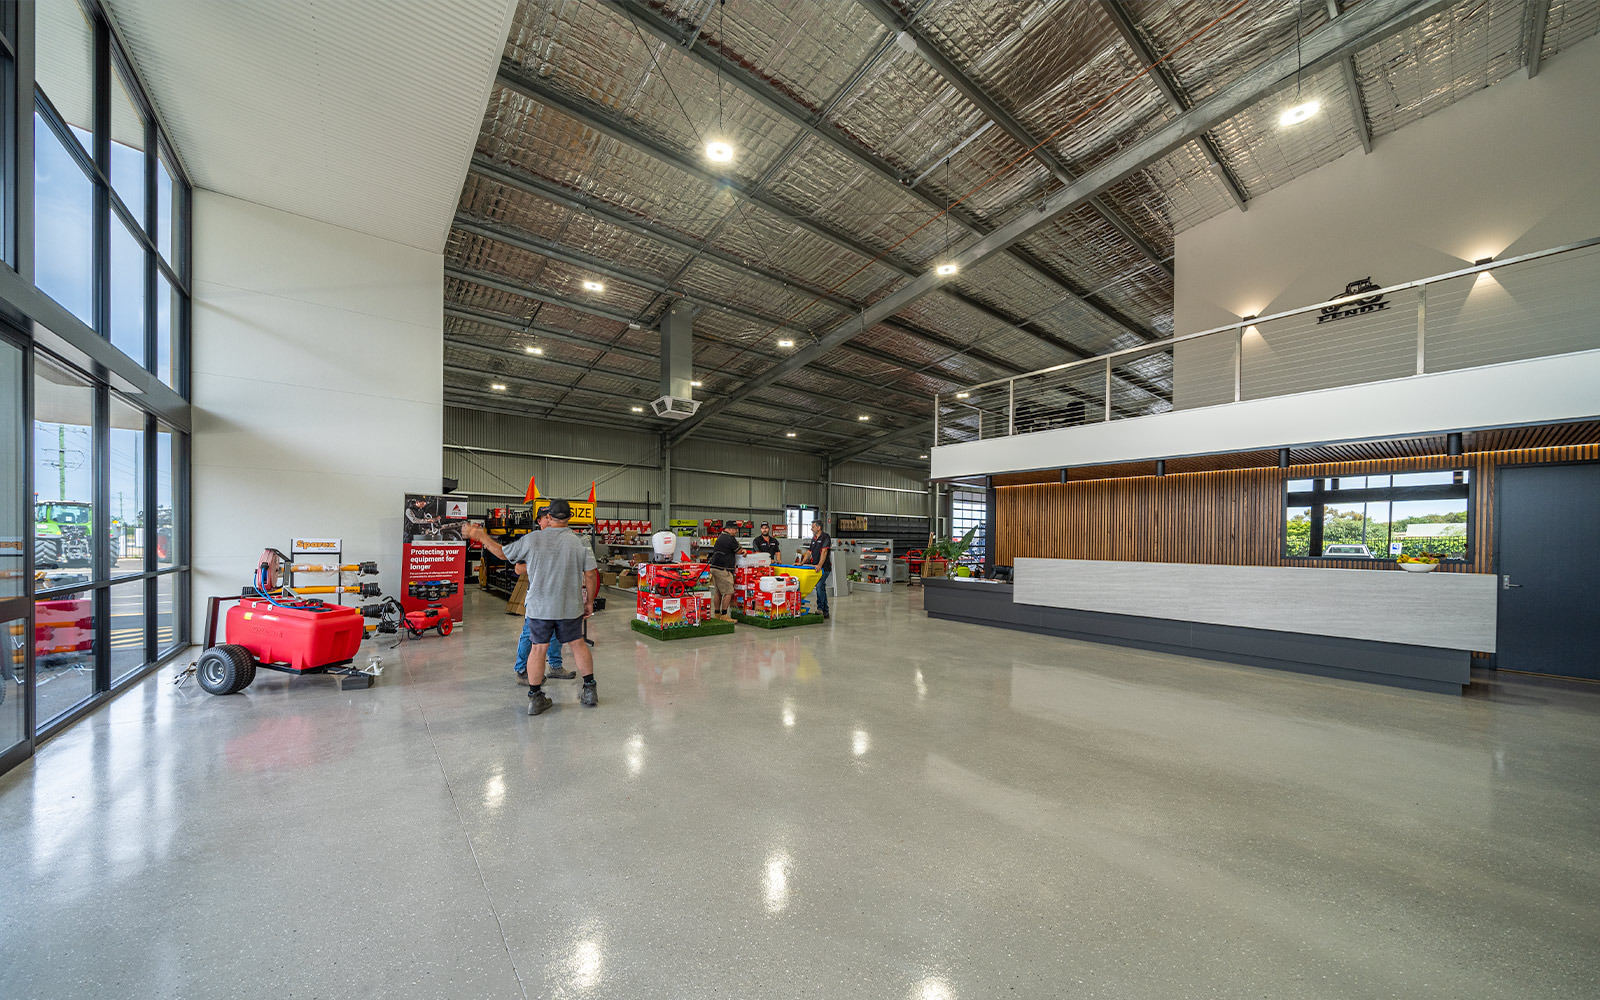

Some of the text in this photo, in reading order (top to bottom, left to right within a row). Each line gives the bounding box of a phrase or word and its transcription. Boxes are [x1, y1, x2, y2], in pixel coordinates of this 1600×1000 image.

[1316, 301, 1391, 325] FENDT
[296, 540, 336, 549] Sparex
[411, 548, 444, 556] Protecting
[410, 555, 444, 563] equipment
[410, 563, 431, 571] longer
